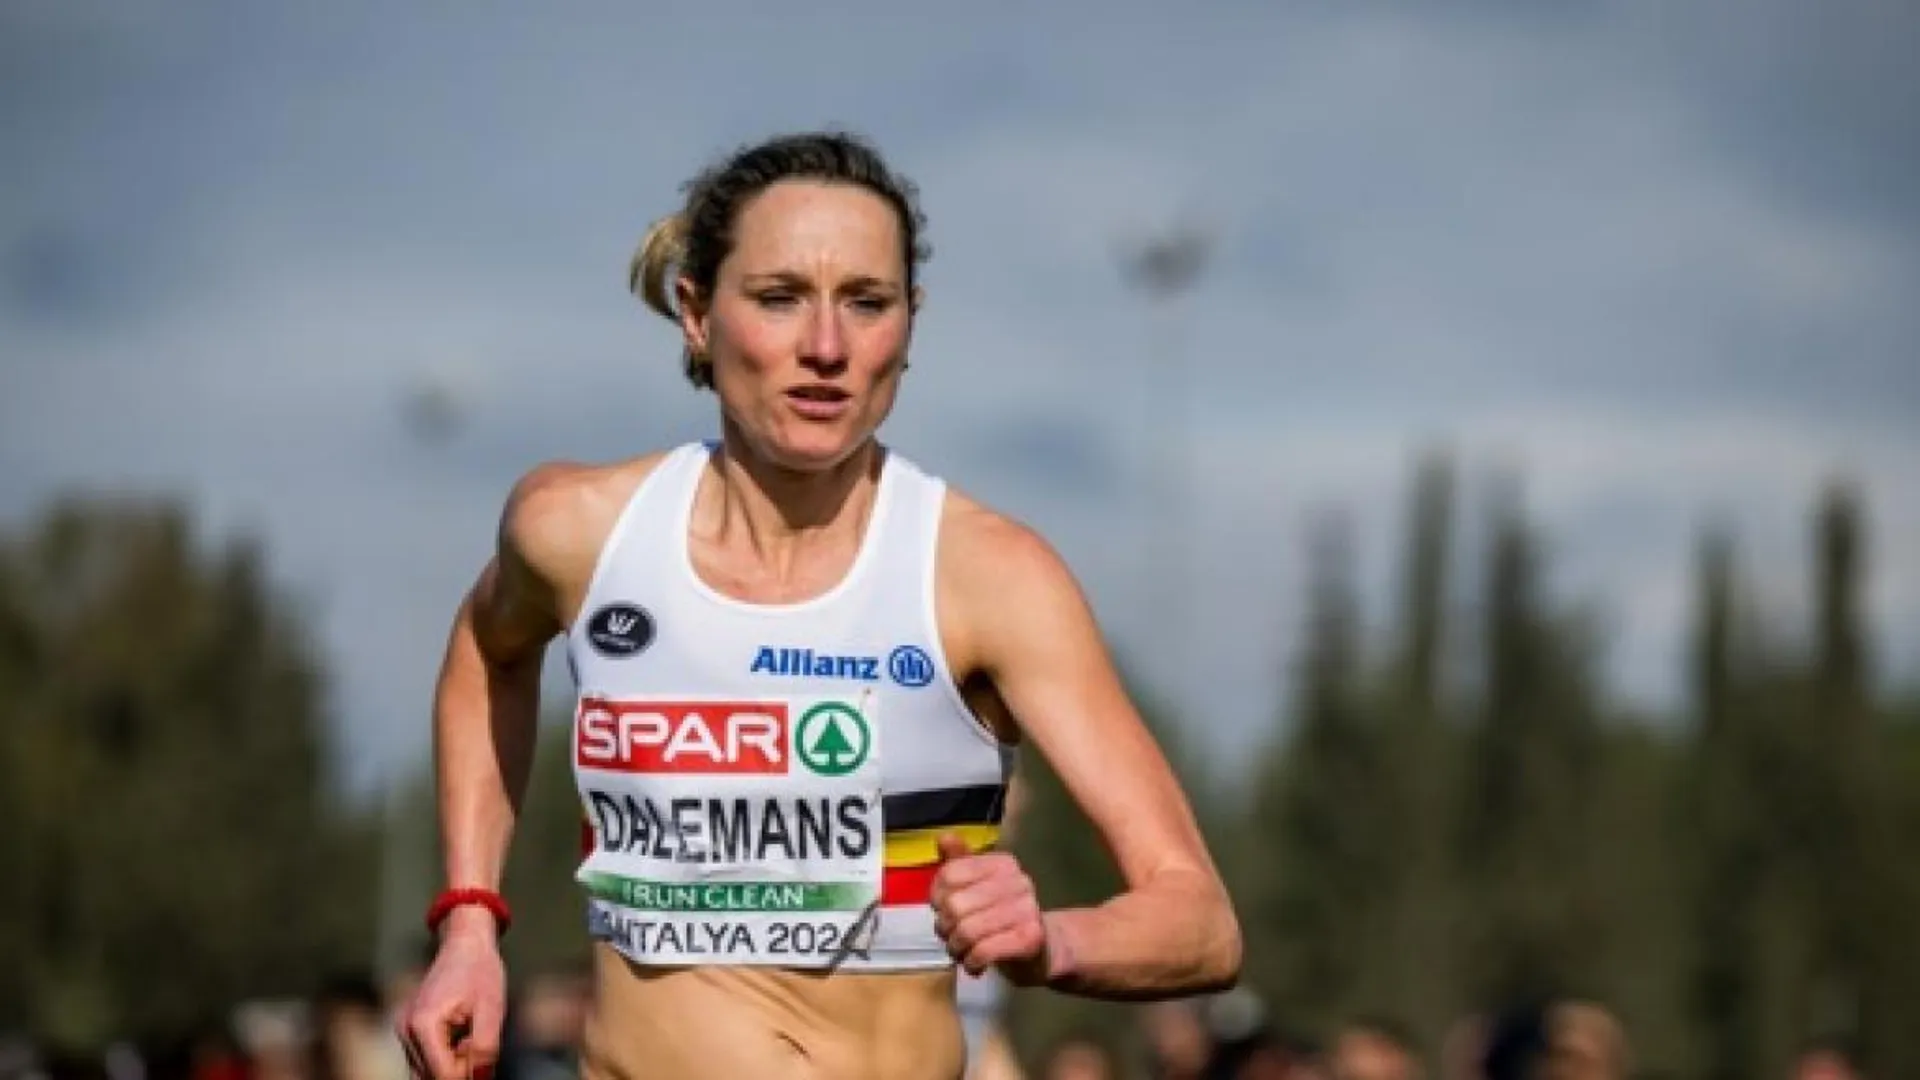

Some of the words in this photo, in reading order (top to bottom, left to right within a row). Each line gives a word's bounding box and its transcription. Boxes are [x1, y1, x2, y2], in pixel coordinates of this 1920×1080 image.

[750, 645, 879, 680] Allianz
[581, 708, 782, 763] SPAR
[590, 790, 870, 863] DALEMANS
[633, 882, 696, 907] RUN
[705, 883, 804, 909] CLEAN
[768, 921, 868, 954] 202
